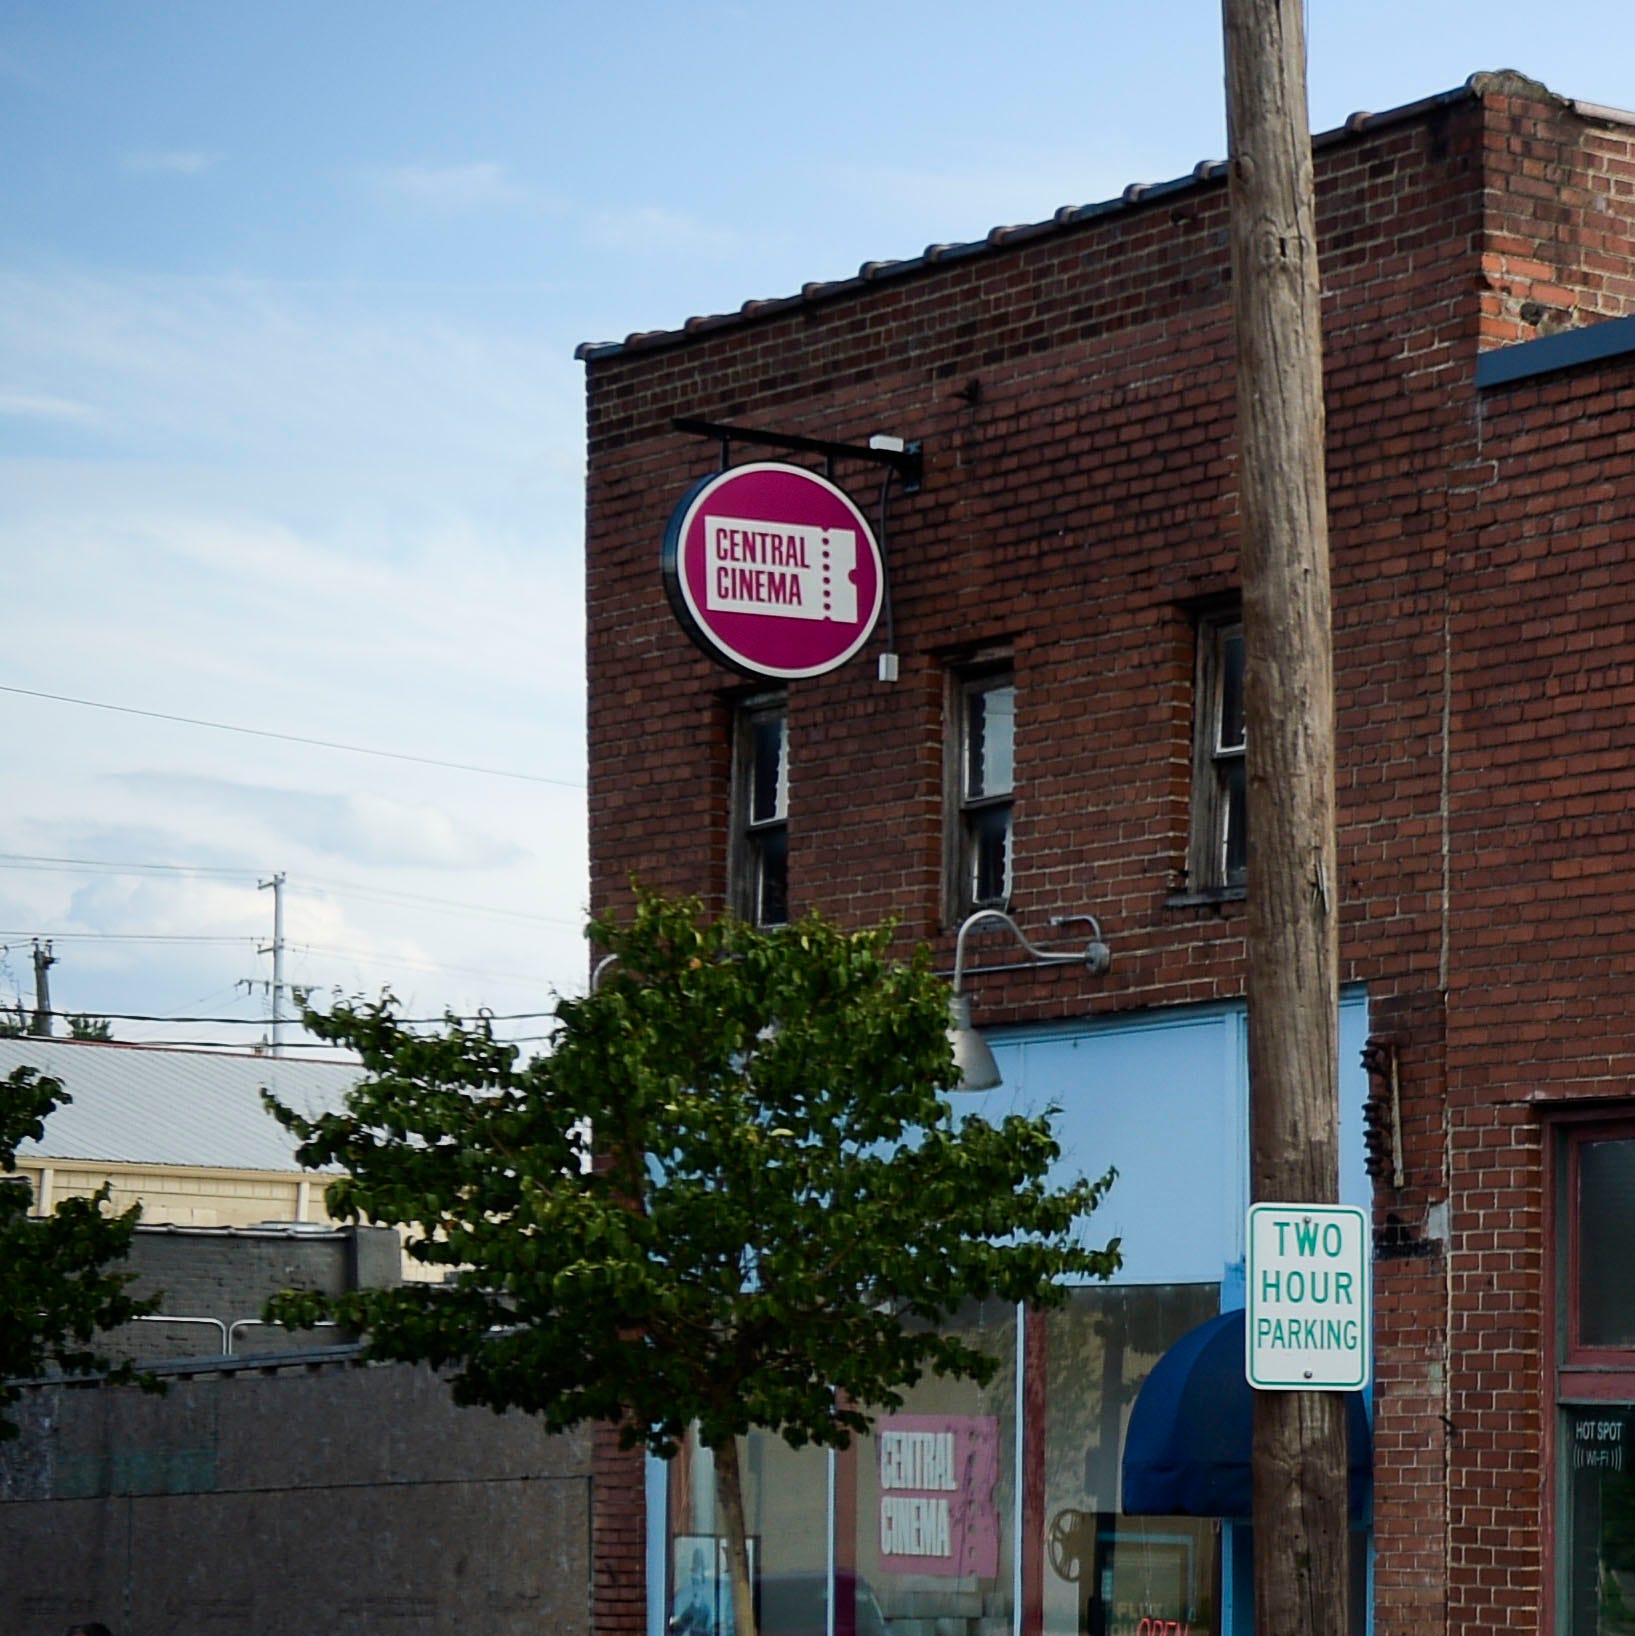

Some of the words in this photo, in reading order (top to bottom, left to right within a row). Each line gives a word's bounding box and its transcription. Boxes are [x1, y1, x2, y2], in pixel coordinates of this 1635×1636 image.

[716, 528, 811, 569] CENTRAL
[716, 566, 802, 606] CINEMA
[1273, 1222, 1342, 1257] TWO
[1262, 1270, 1353, 1304] HOUR
[1257, 1318, 1358, 1350] PARKING
[1575, 1421, 1596, 1440] HOT
[1597, 1421, 1622, 1440] SPOT
[880, 1431, 957, 1490] CENTRAL
[880, 1496, 951, 1556] CINEMA
